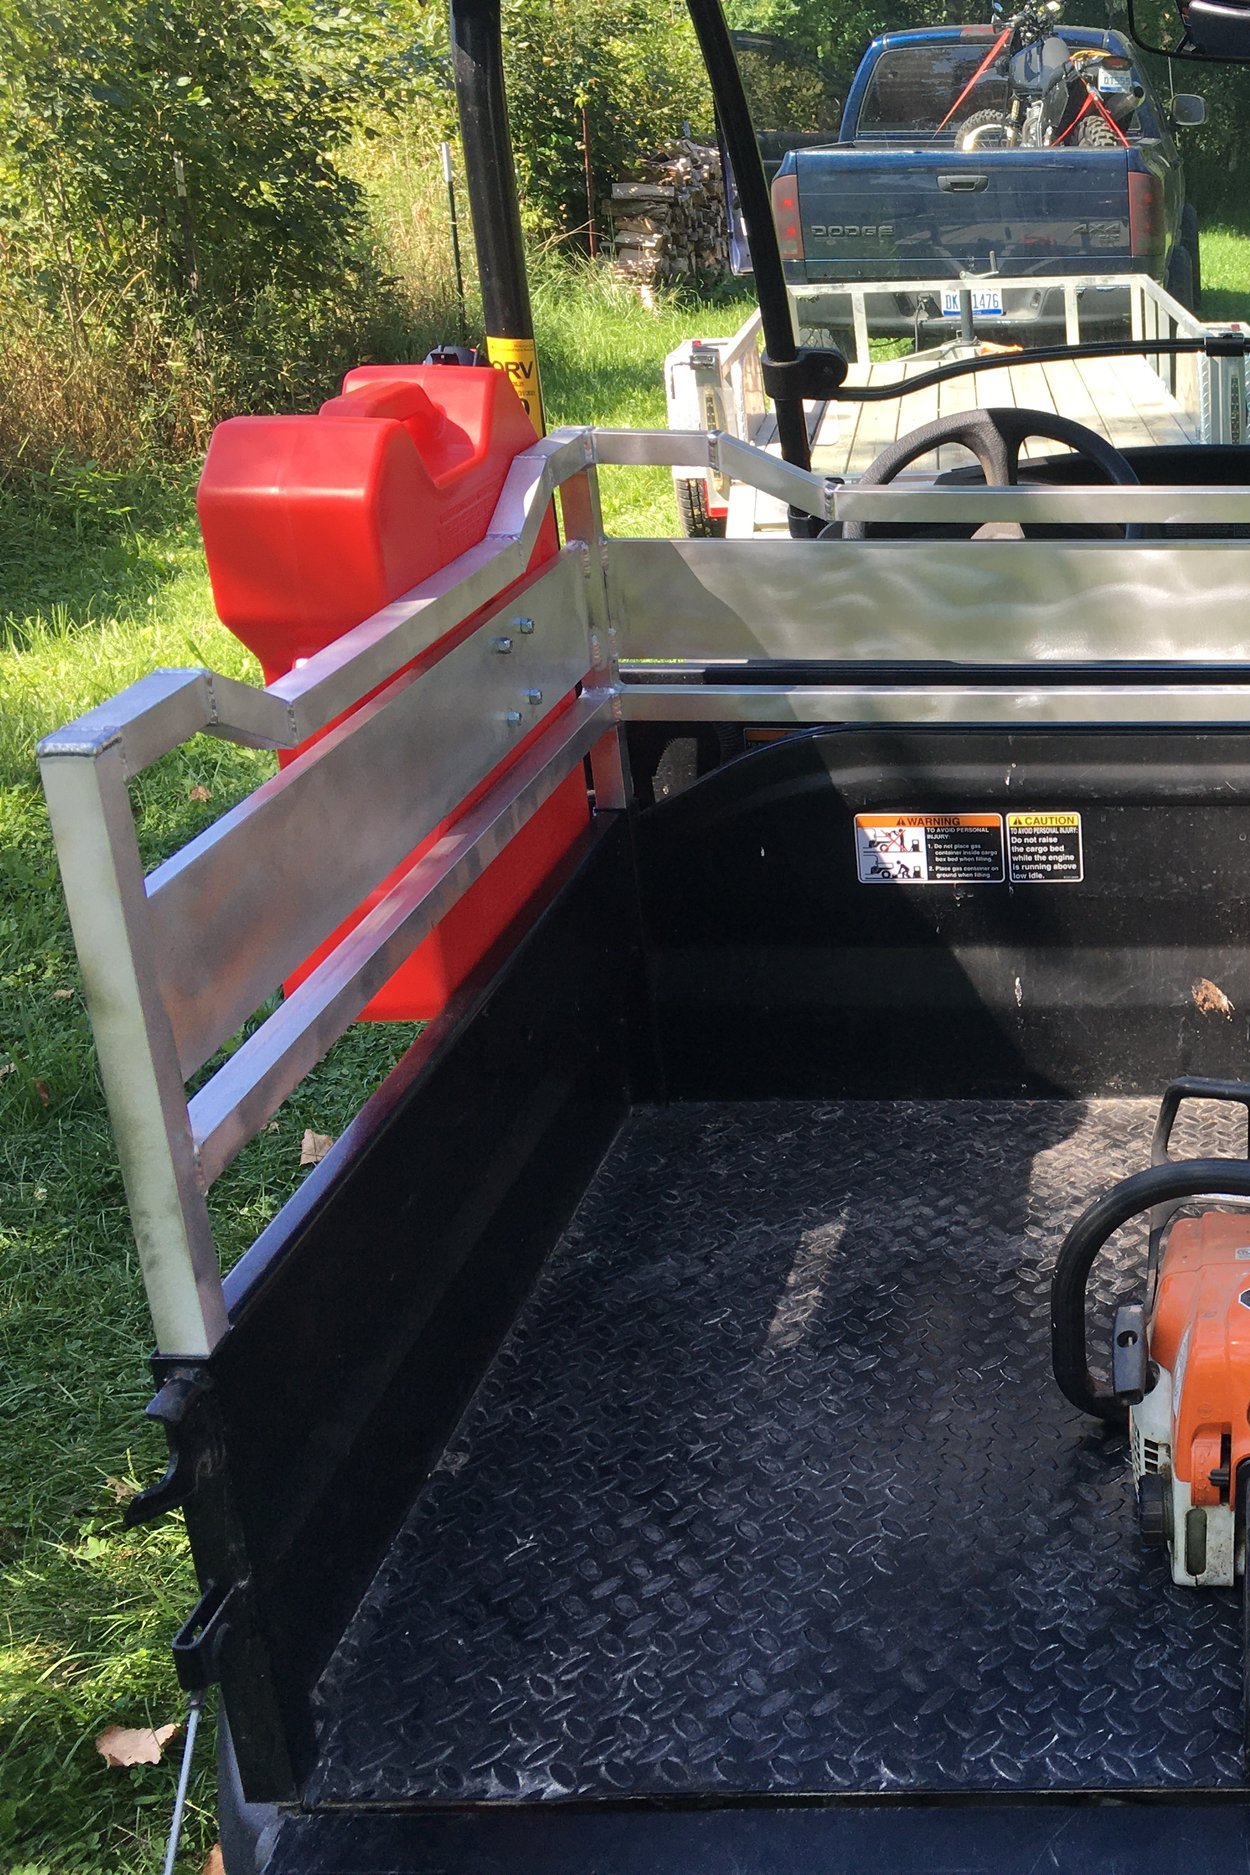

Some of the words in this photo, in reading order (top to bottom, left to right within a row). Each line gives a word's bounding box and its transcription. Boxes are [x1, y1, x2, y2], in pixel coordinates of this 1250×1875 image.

[811, 225, 895, 236] DODGE
[972, 293, 999, 309] 1476
[907, 816, 960, 826] WARNING
[1024, 816, 1075, 826] CAUTION
[1011, 836, 1022, 844] Do
[1038, 835, 1059, 843] raise
[1011, 845, 1024, 853] the
[1025, 846, 1049, 854] cargo
[1011, 854, 1033, 862] while
[1048, 854, 1075, 862] engine
[1012, 863, 1020, 871] is
[1021, 863, 1052, 872] running
